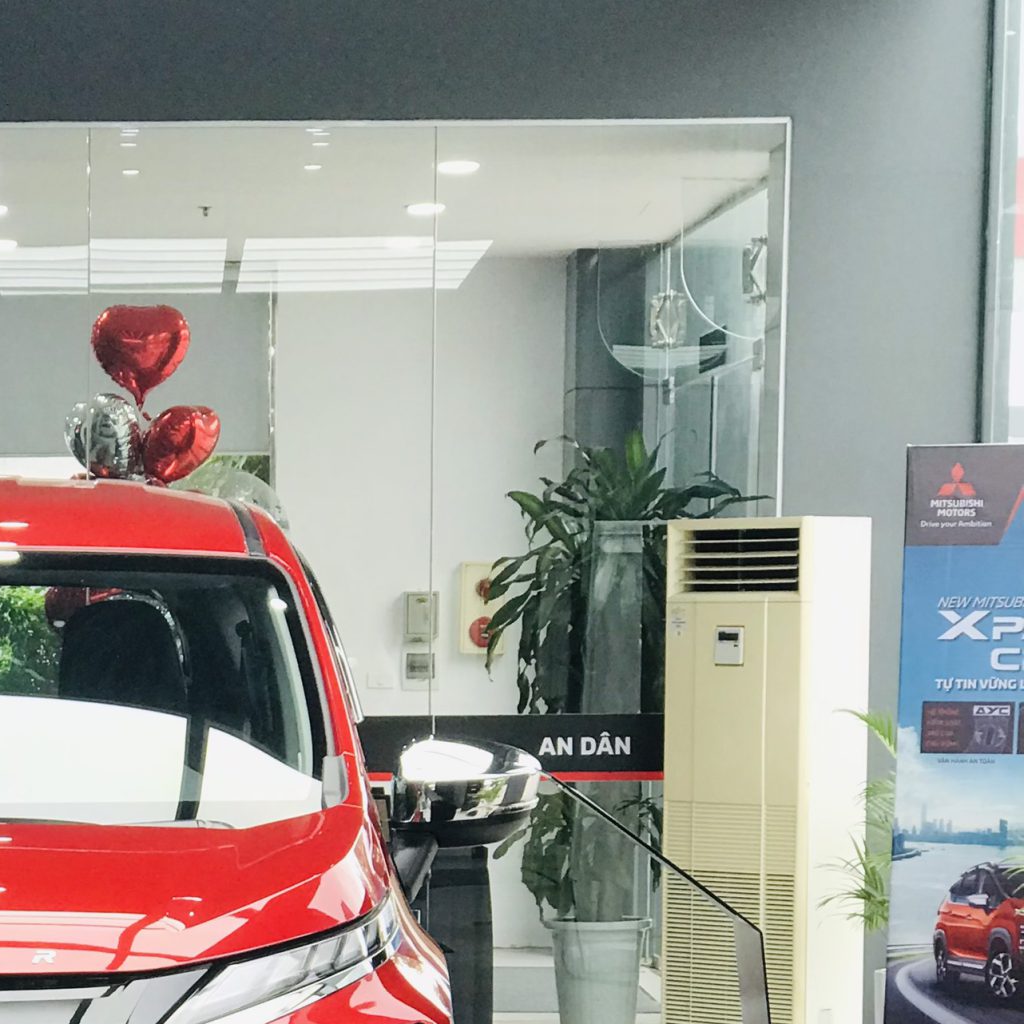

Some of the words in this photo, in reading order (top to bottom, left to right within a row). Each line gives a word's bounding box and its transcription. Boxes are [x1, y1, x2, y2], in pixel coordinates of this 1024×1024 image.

[930, 499, 984, 508] MITSUBISHI
[937, 508, 977, 517] MOTORS
[920, 520, 940, 528] Drive
[940, 521, 957, 529] your
[958, 520, 993, 528] Ambition
[937, 596, 972, 608] NEW
[972, 596, 1024, 608] MITSUB
[937, 610, 1024, 640] XP
[990, 647, 1024, 671] C
[935, 677, 955, 692] TỰ
[956, 679, 977, 690] TIN
[979, 676, 1017, 690] VỮNG
[975, 706, 1010, 715] AYC
[538, 736, 574, 756] AN
[580, 731, 632, 756] DÂN
